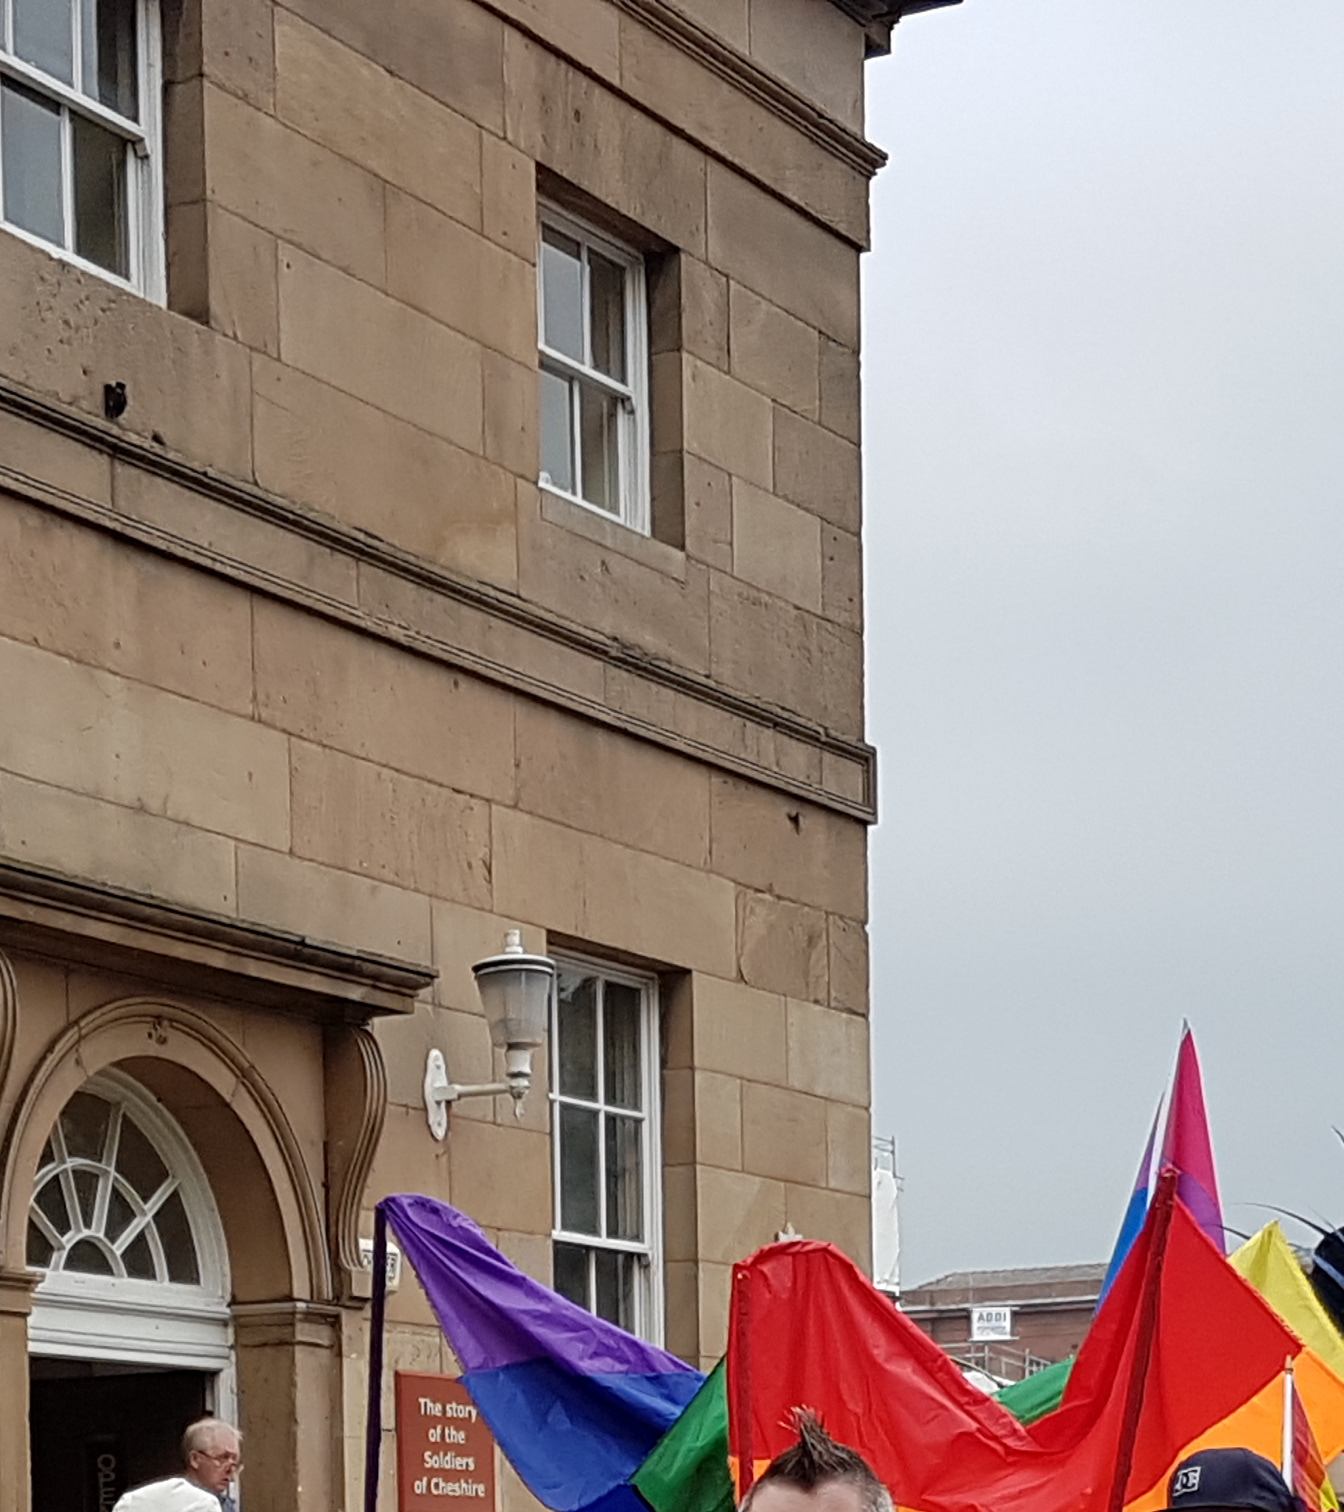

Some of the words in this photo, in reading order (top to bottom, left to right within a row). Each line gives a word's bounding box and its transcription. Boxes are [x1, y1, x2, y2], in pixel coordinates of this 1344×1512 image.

[418, 1397, 442, 1416] The
[446, 1402, 477, 1423] story
[428, 1425, 442, 1442] of
[445, 1426, 466, 1443] the
[424, 1451, 475, 1471] Soldiers
[414, 1477, 427, 1494] of
[431, 1478, 485, 1497] Cheshire
